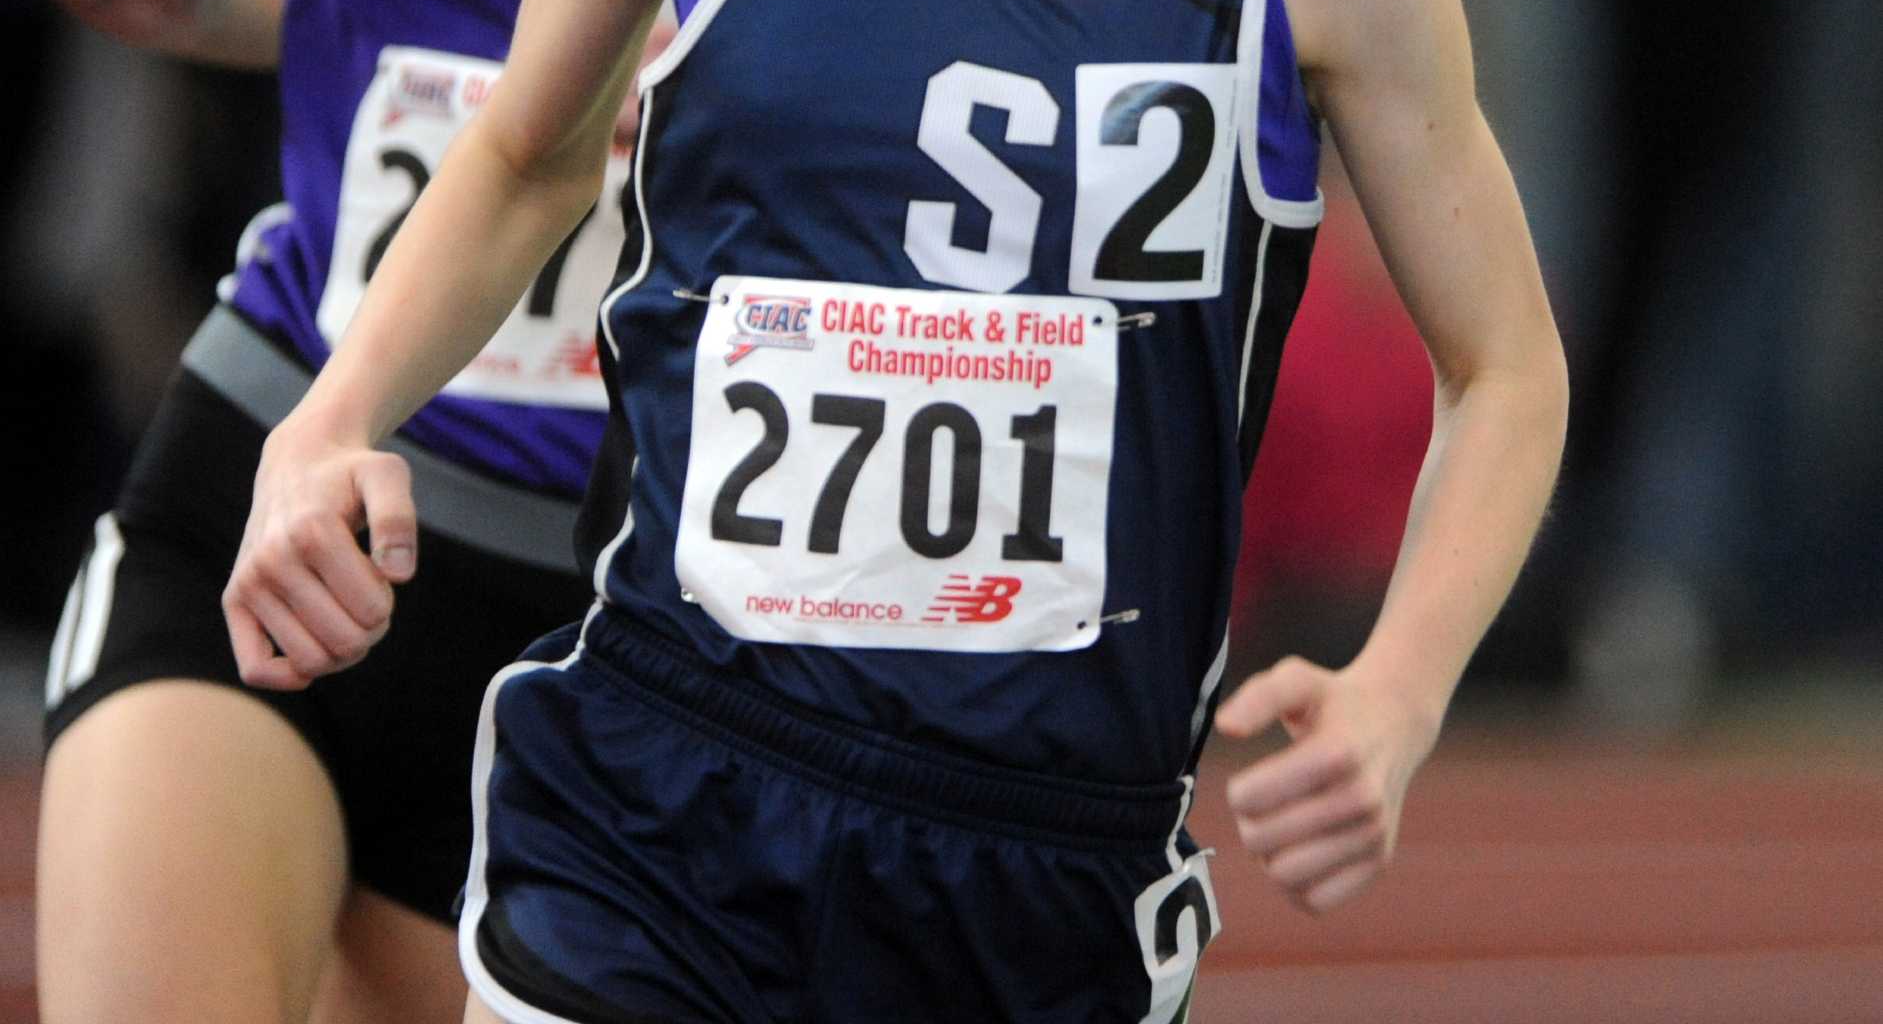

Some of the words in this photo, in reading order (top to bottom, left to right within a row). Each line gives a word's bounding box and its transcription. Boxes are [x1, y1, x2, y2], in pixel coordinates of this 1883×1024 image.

[903, 60, 1061, 294] S
[1092, 80, 1216, 282] 2
[747, 303, 812, 333] CIAC
[821, 298, 886, 336] CIAC
[896, 305, 974, 342] Track
[985, 310, 1006, 343] &
[1016, 312, 1084, 347] Field
[848, 339, 1054, 389] Championship
[711, 380, 1063, 563] 2701
[746, 594, 793, 615] new
[800, 595, 903, 622] balance
